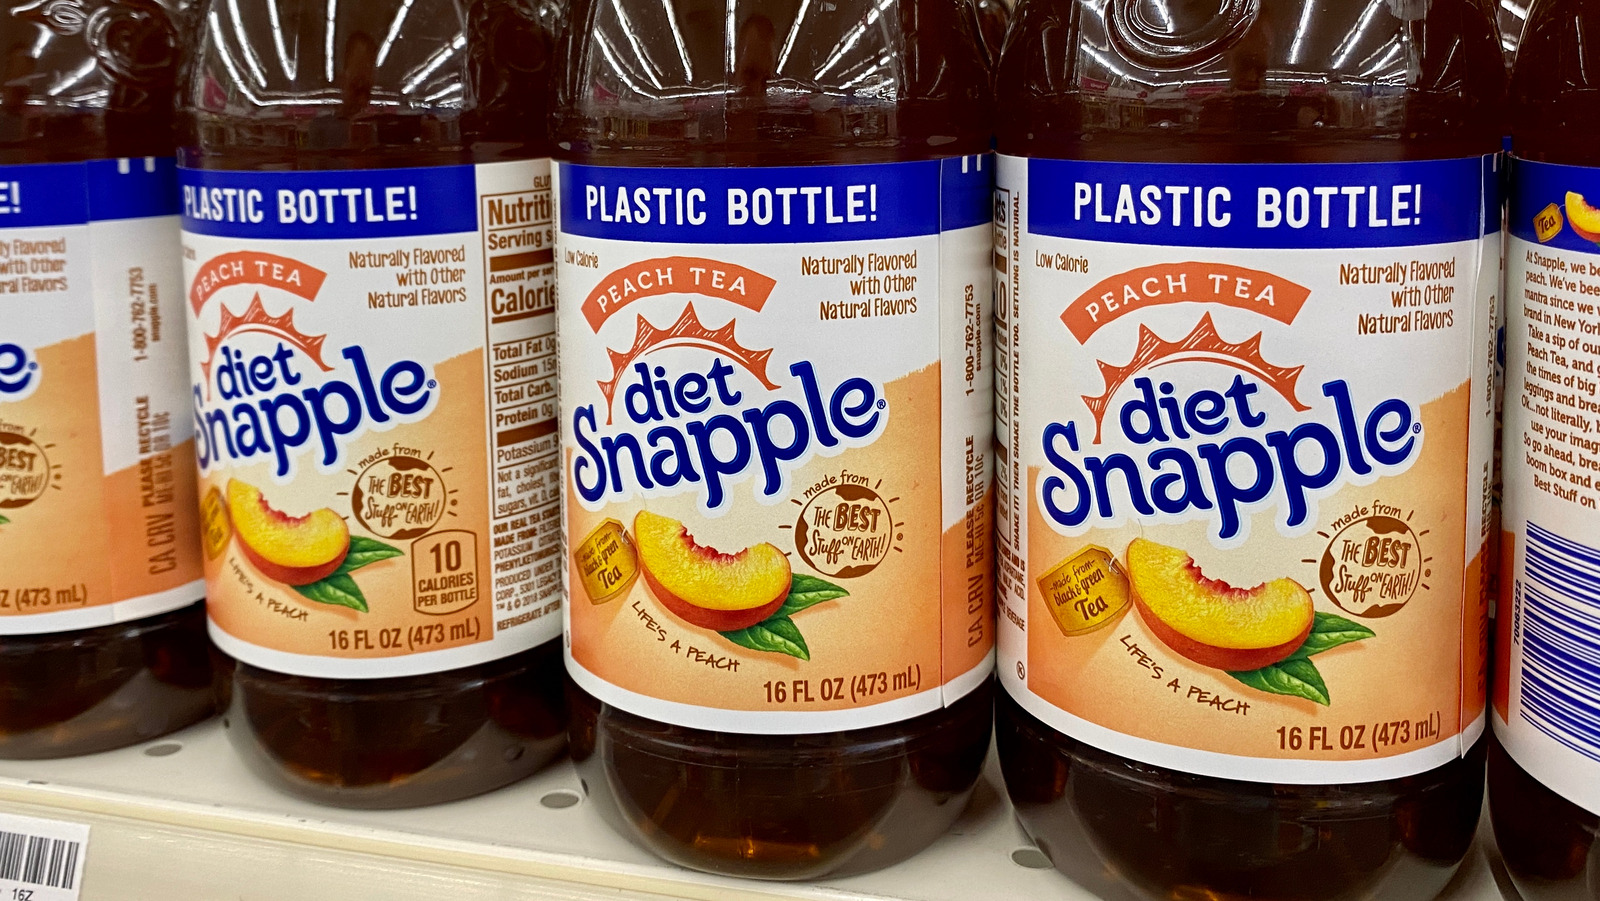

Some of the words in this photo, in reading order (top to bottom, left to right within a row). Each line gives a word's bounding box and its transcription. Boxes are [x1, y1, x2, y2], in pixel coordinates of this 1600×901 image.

[183, 185, 264, 223] PLASTIC
[277, 186, 418, 224] BOTTLE!
[586, 185, 706, 225] PLASTIC
[728, 184, 877, 226] BOTTLE!
[1074, 181, 1231, 228] PLASTIC
[1256, 183, 1421, 229] BOTTLE!
[1538, 215, 1556, 234] Tea
[13, 237, 66, 255] Flavored
[488, 229, 542, 250] Serving
[31, 258, 66, 273] Other
[350, 248, 410, 269] Naturally
[414, 245, 465, 265] Flavored
[576, 250, 598, 269] Calorie
[801, 254, 864, 276] Naturally
[868, 250, 917, 271] Flavored
[1014, 250, 1020, 262] IS
[1035, 249, 1053, 269] Low
[1055, 253, 1088, 274] Calorie
[1526, 250, 1533, 263] At
[1534, 253, 1568, 274] Snapple,
[1570, 262, 1586, 274] we
[22, 276, 68, 292] Flavors
[196, 260, 244, 296] PEACH
[254, 260, 301, 286] TEA
[396, 271, 427, 286] with
[430, 268, 466, 283] Other
[490, 270, 525, 284] Amount
[527, 269, 540, 281] per
[850, 280, 881, 296] with
[884, 274, 917, 292] Other
[1339, 261, 1407, 287] Naturally
[1410, 257, 1455, 281] Flavored
[1525, 271, 1547, 286] peach.
[1549, 275, 1576, 292] We've
[368, 290, 418, 309] Natural
[421, 287, 466, 304] Flavors
[597, 267, 673, 313] PEACH
[690, 267, 746, 296] TEA
[1085, 273, 1187, 323] PEACH
[1208, 273, 1275, 306] TEA
[1391, 288, 1421, 308] with
[1424, 284, 1454, 305] Other
[1525, 288, 1548, 305] mantra
[1550, 295, 1574, 311] since
[1577, 303, 1593, 315] we
[129, 266, 149, 362] 1-800-762-7753
[820, 300, 871, 321] Natural
[874, 297, 917, 316] Flavors
[1358, 311, 1411, 335] Natural
[1414, 309, 1453, 331] Flavors
[1524, 304, 1542, 322] brand
[1544, 311, 1551, 325] in
[1554, 314, 1576, 331] New
[493, 344, 522, 361] Total
[526, 341, 543, 355] Fat
[965, 284, 974, 396] 1-800-762-7753
[1528, 324, 1543, 341] Take
[1552, 334, 1566, 351] sip
[1568, 338, 1579, 351] of
[217, 342, 301, 401] diet
[1528, 342, 1548, 362] Peach
[1550, 351, 1568, 368] Tea,
[1572, 358, 1593, 374] and
[494, 364, 538, 382] Sodium
[1527, 361, 1536, 375] the
[1539, 367, 1561, 384] times
[1564, 374, 1575, 388] of
[1578, 376, 1596, 396] big
[495, 386, 524, 404] Total
[527, 380, 553, 397] Carb.
[625, 357, 742, 424] diet
[1524, 377, 1553, 402] leggings
[1556, 393, 1575, 408] and
[496, 408, 538, 427] Protein
[1120, 374, 1266, 444] diet
[1551, 407, 1592, 433] literally,
[136, 396, 149, 454] RECYCLE
[1531, 420, 1543, 434] use
[1545, 427, 1567, 443] your
[392, 443, 422, 458] from
[498, 438, 551, 462] Potassium
[1524, 432, 1531, 445] So
[1533, 438, 1541, 453] go
[1544, 443, 1575, 465] ahead,
[966, 435, 974, 504] RECYCLE
[1526, 452, 1547, 474] boom
[1549, 462, 1567, 481] box
[1570, 472, 1591, 489] and
[387, 473, 434, 499] BEST
[803, 474, 837, 499] made
[840, 469, 869, 487] from
[1534, 474, 1551, 493] Best
[1553, 483, 1577, 502] Stuff
[1580, 495, 1596, 509] on
[405, 499, 439, 524] EARTH!
[814, 506, 833, 529] THE
[833, 503, 881, 533] BEST
[1331, 505, 1369, 531] made
[1372, 500, 1401, 518] from
[430, 540, 461, 574] 10
[809, 529, 844, 564] Stuff
[852, 534, 886, 561] EARTH!
[1341, 539, 1362, 564] THE
[1362, 536, 1411, 568] BEST
[418, 572, 474, 593] CALORIES
[598, 564, 622, 589] Tea
[1081, 568, 1104, 595] green
[1335, 565, 1372, 602] Stuff
[1379, 570, 1415, 599] EARTH!
[15, 587, 50, 612] (473
[56, 583, 87, 605] mL)
[418, 594, 439, 608] PER
[440, 588, 476, 605] BOTTLE
[968, 573, 984, 615] CRV
[1074, 595, 1109, 621] Tea
[329, 630, 348, 650] 16
[354, 630, 374, 650] FL
[379, 628, 402, 648] OZ
[408, 625, 445, 650] (473
[450, 617, 481, 641] mL)
[632, 601, 667, 642] LIFE'S
[670, 640, 681, 653] A
[687, 646, 740, 672] PEACH
[968, 616, 984, 648] CA
[764, 681, 786, 703] 16
[793, 680, 814, 702] FL
[820, 678, 844, 700] OZ
[851, 672, 887, 703] (473
[893, 664, 920, 691] mL)
[1120, 635, 1164, 680] LIFE'S
[1167, 678, 1180, 693] A
[1187, 686, 1250, 716] PEACH
[1277, 726, 1302, 750] 16
[1309, 727, 1333, 750] FL
[1340, 725, 1365, 749] OZ
[1372, 720, 1410, 752] (473
[1415, 711, 1440, 741] mL)
